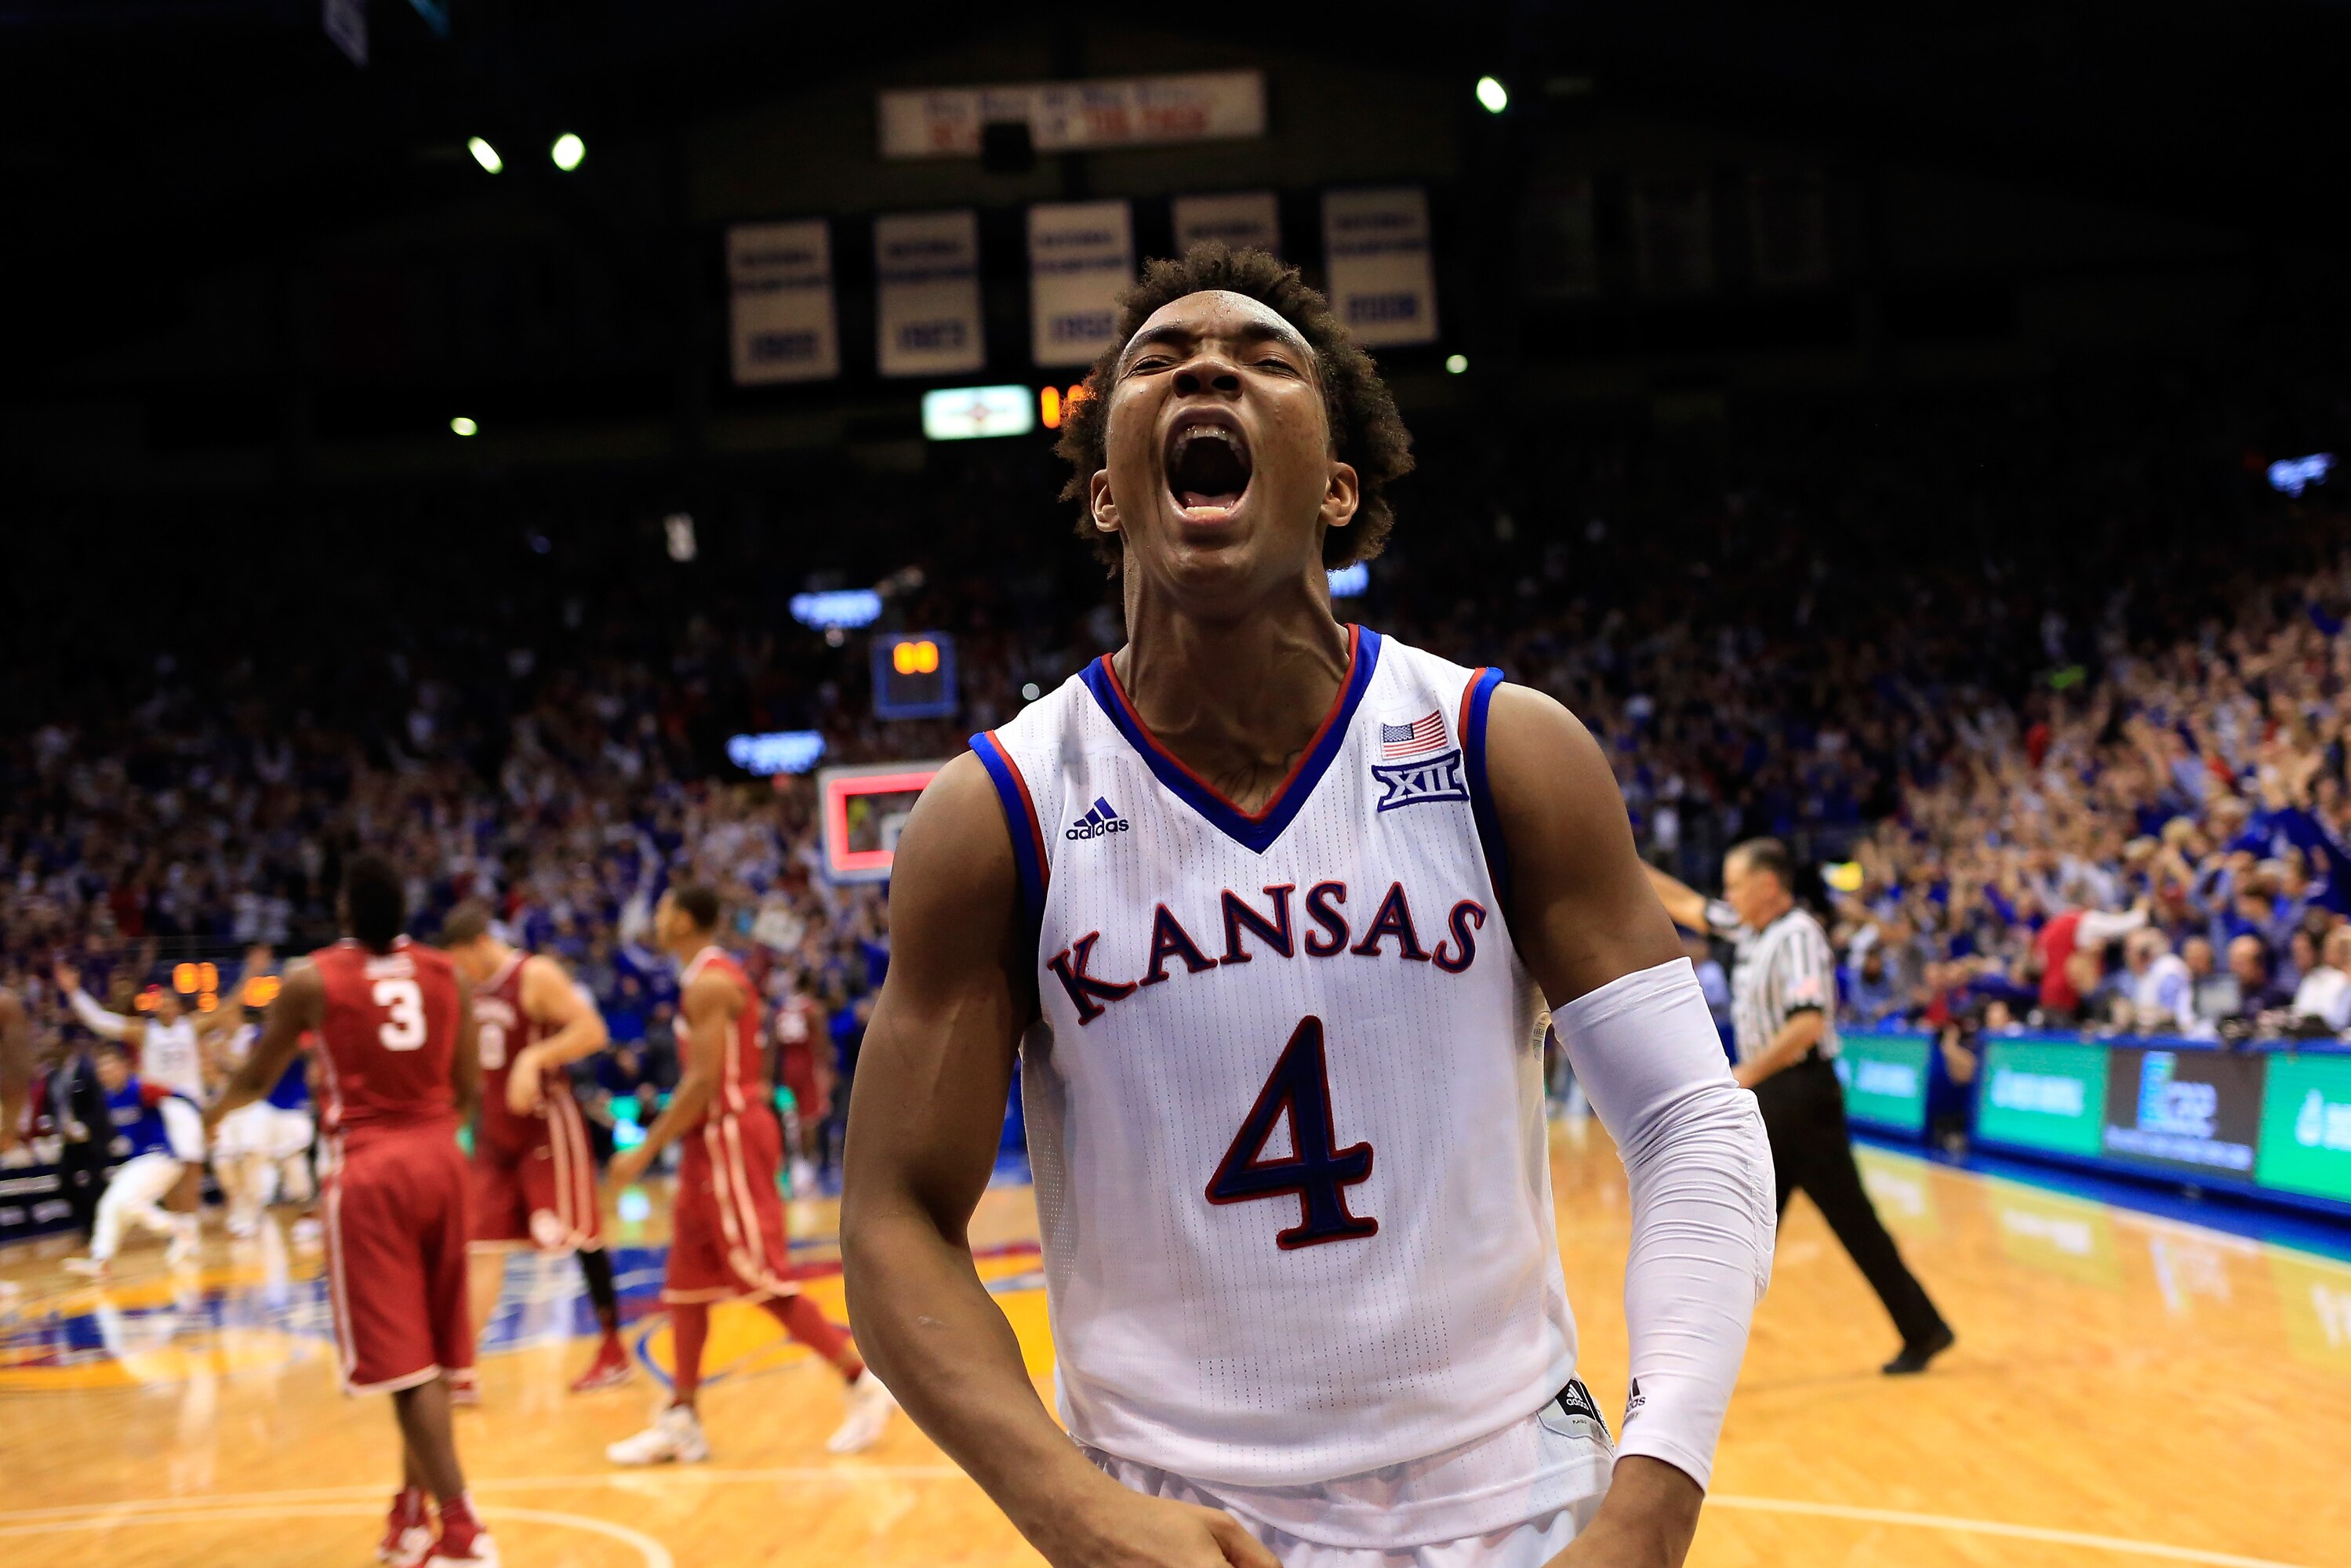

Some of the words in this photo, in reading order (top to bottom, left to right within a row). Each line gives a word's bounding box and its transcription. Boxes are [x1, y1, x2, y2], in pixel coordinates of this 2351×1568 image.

[1377, 756, 1463, 806] XII
[1066, 819, 1129, 840] adidas
[1047, 881, 1487, 1026] KANSAS
[372, 979, 427, 1051] 3
[1205, 1014, 1379, 1250] 4
